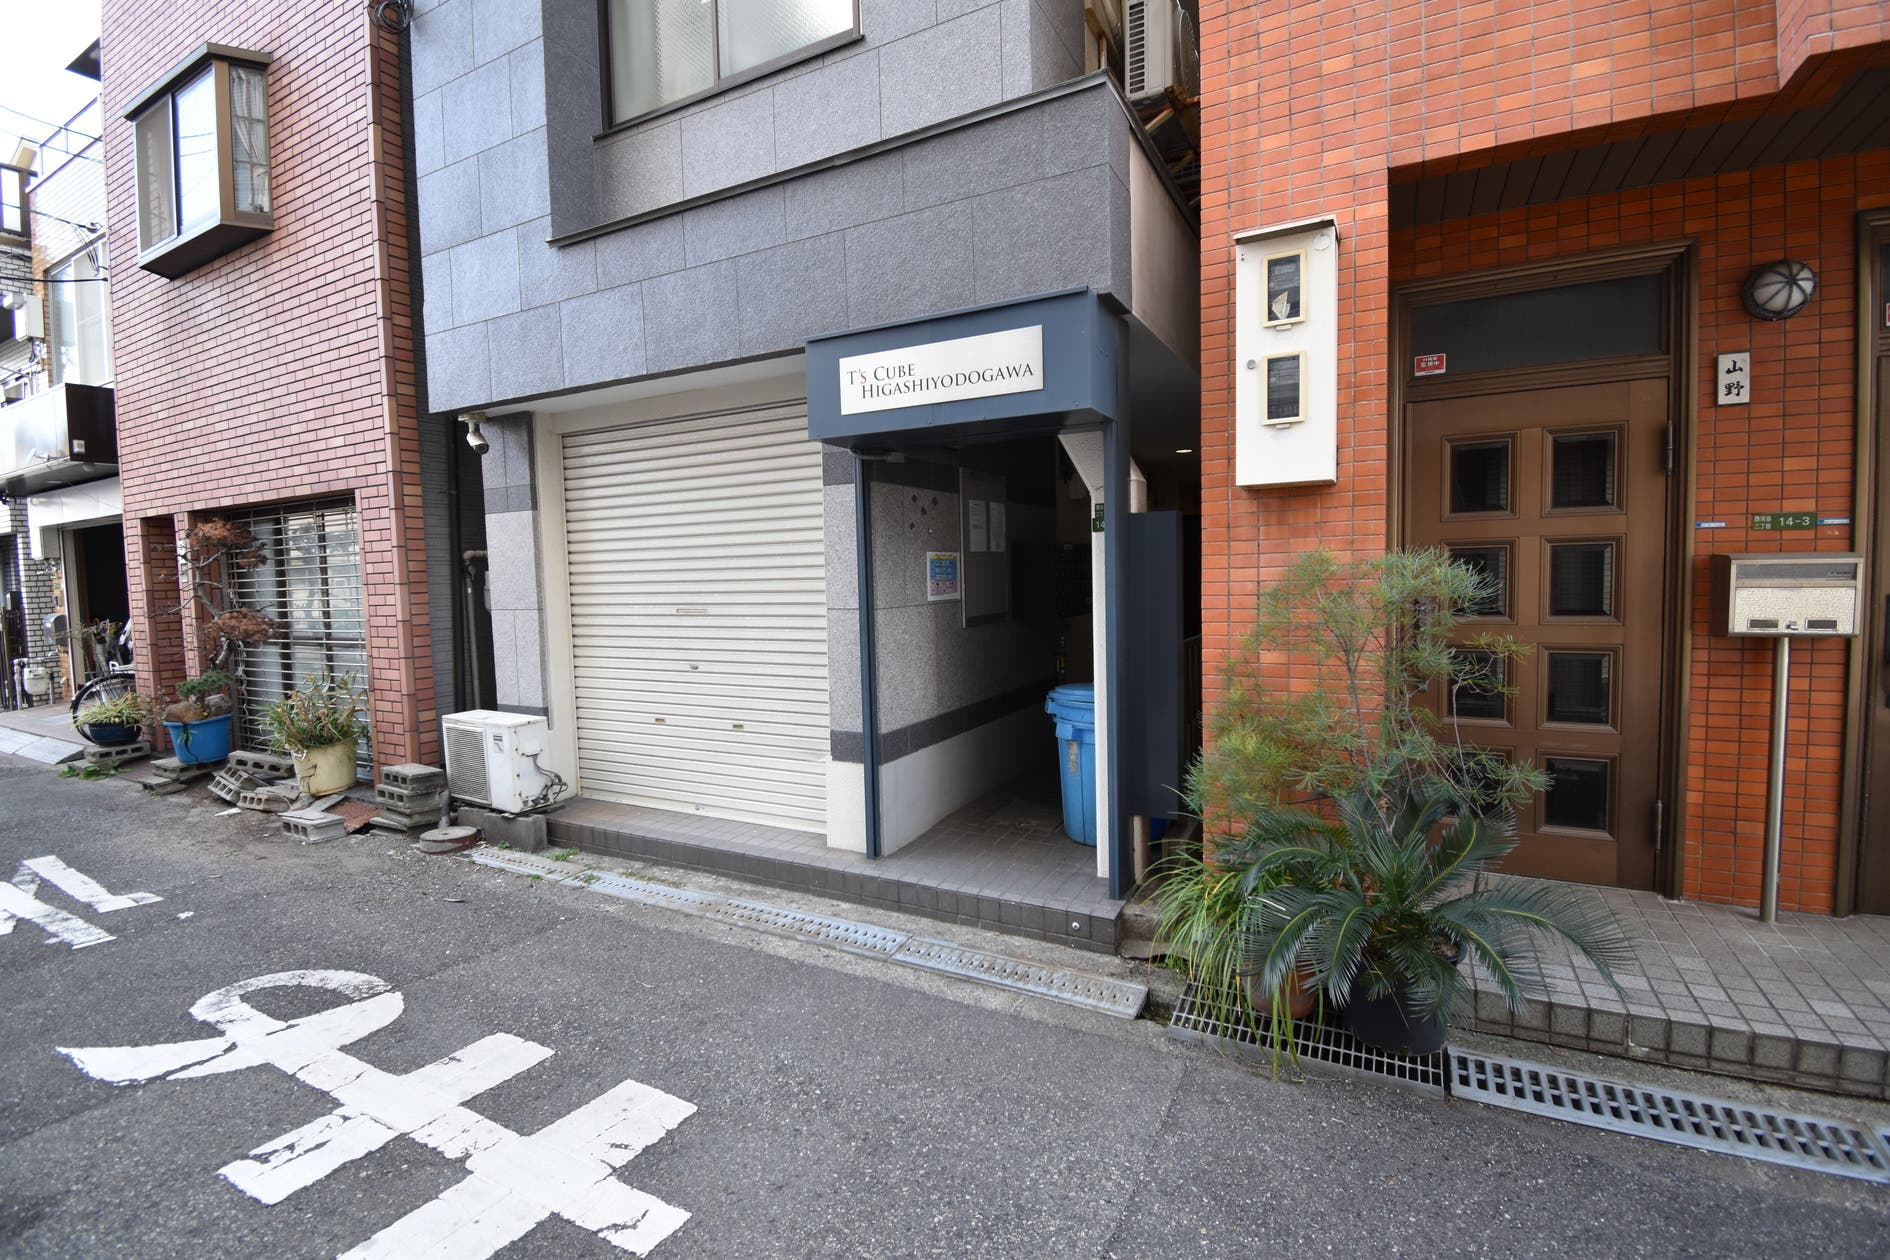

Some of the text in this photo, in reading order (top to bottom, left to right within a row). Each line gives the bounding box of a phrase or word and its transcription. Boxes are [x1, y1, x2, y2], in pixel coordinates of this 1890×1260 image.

[862, 363, 1034, 399] HIGASHIYODOGAWA
[1724, 359, 1745, 397] 山野
[1779, 516, 1810, 526] 14-3
